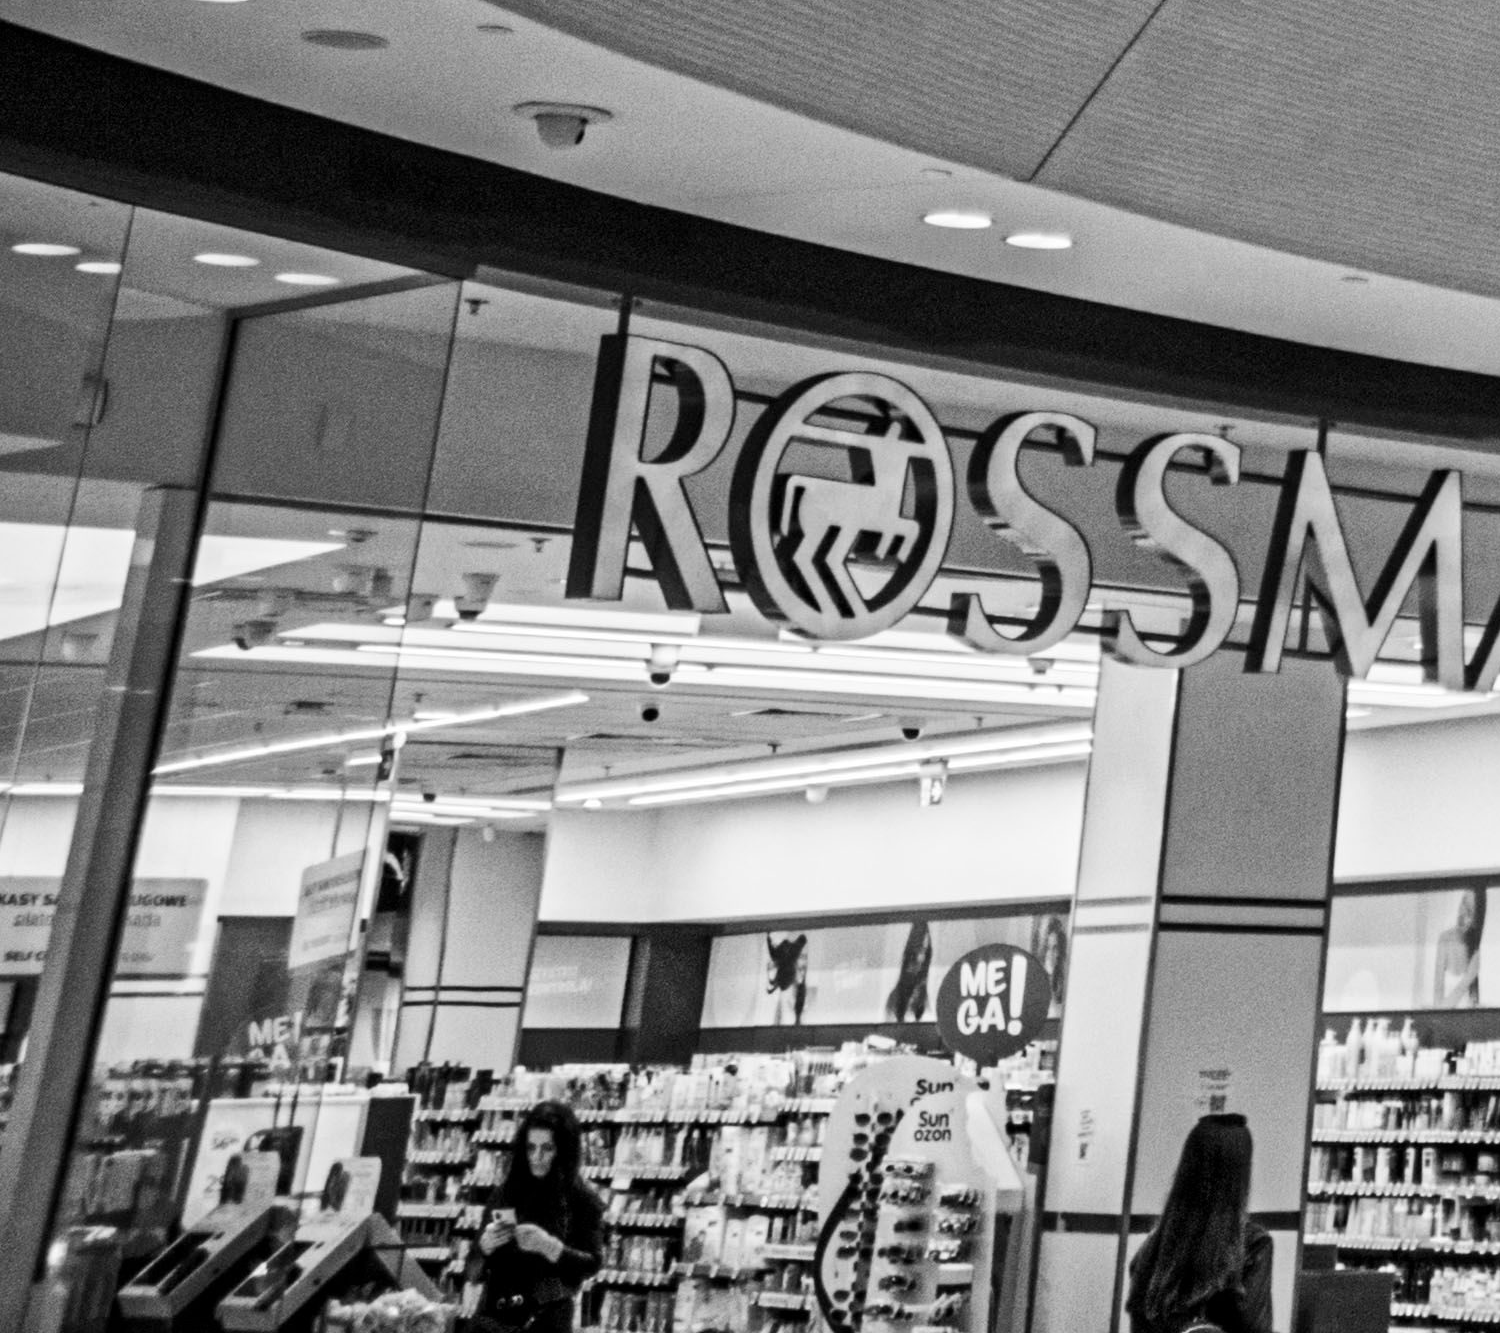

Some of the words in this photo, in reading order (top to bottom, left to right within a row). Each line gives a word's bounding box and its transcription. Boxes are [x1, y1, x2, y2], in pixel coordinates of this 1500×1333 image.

[916, 1078, 954, 1095] Sun
[918, 1110, 950, 1128] Sun
[914, 1128, 952, 1142] ozon
